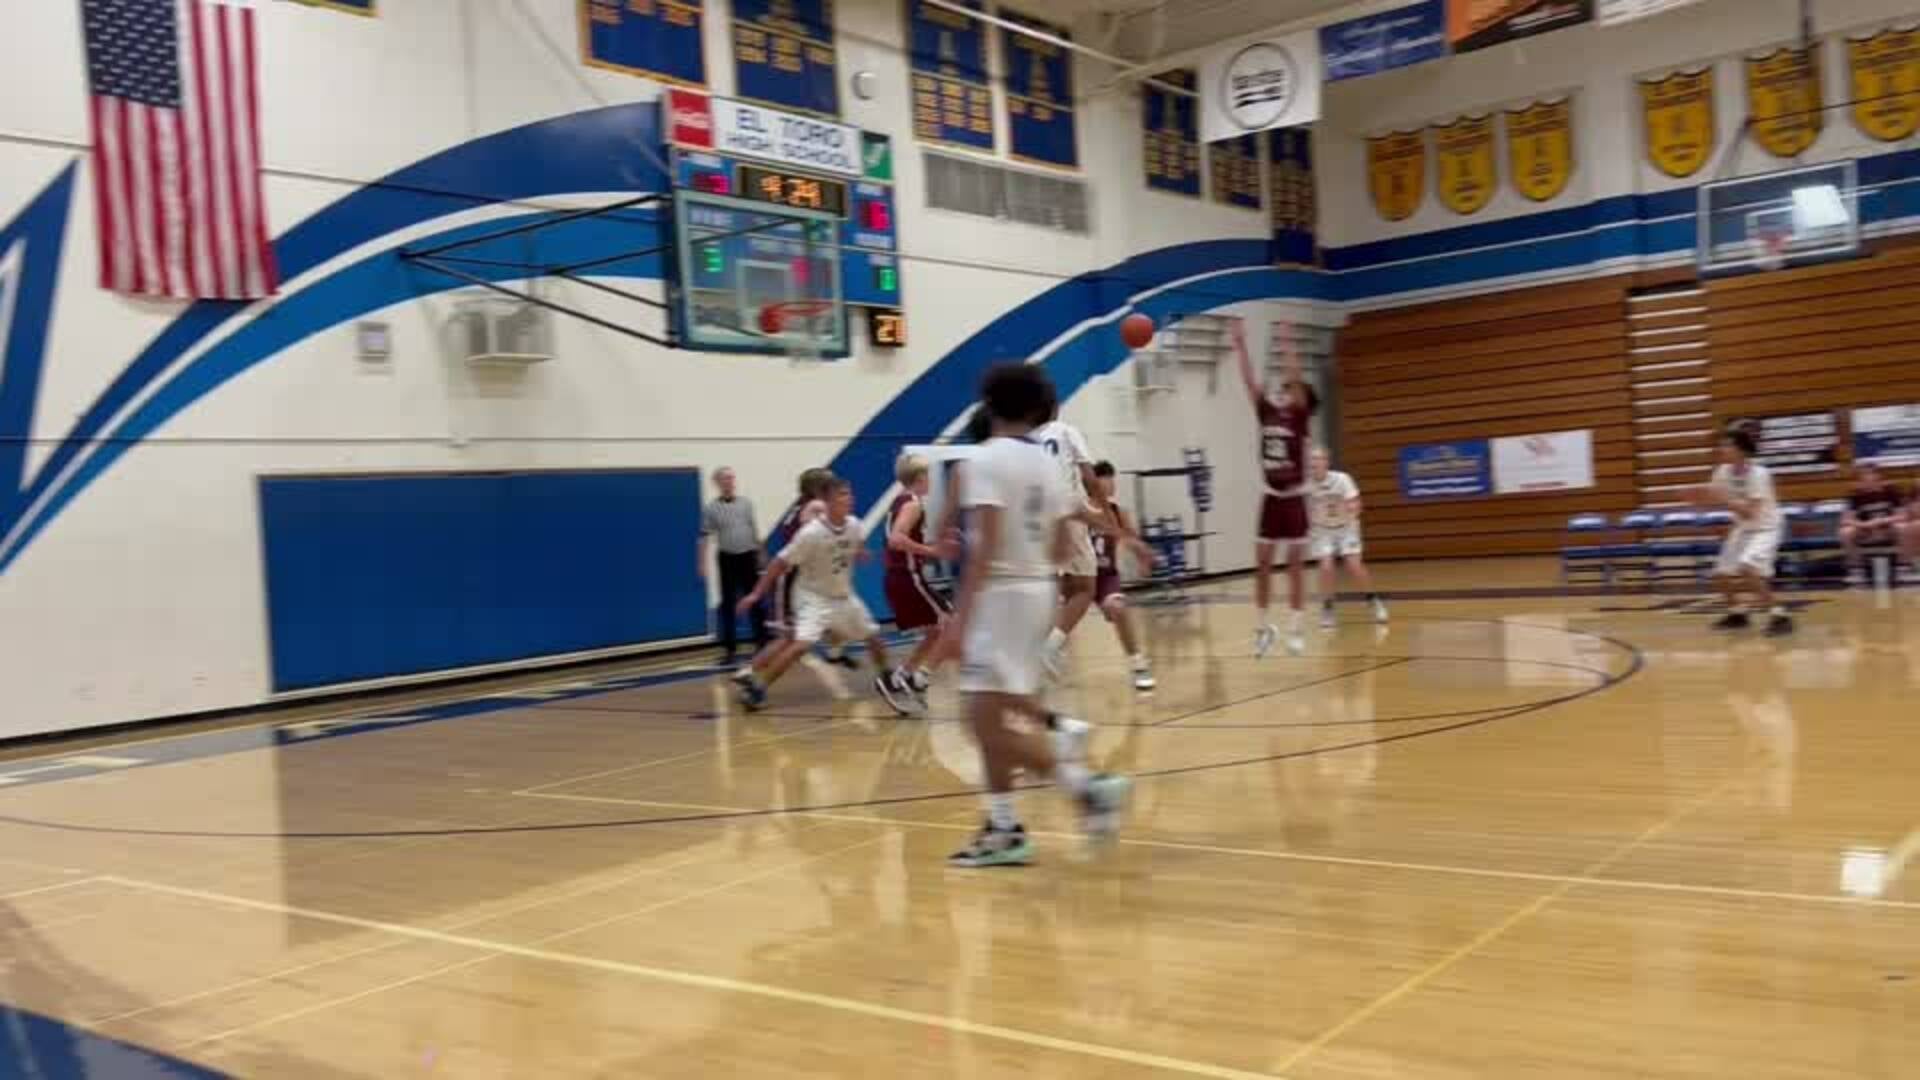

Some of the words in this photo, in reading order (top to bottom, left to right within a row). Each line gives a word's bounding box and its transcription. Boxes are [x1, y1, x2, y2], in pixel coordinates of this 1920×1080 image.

[736, 107, 769, 134] EL
[780, 116, 843, 149] TORO
[782, 142, 855, 171] SCHOOL
